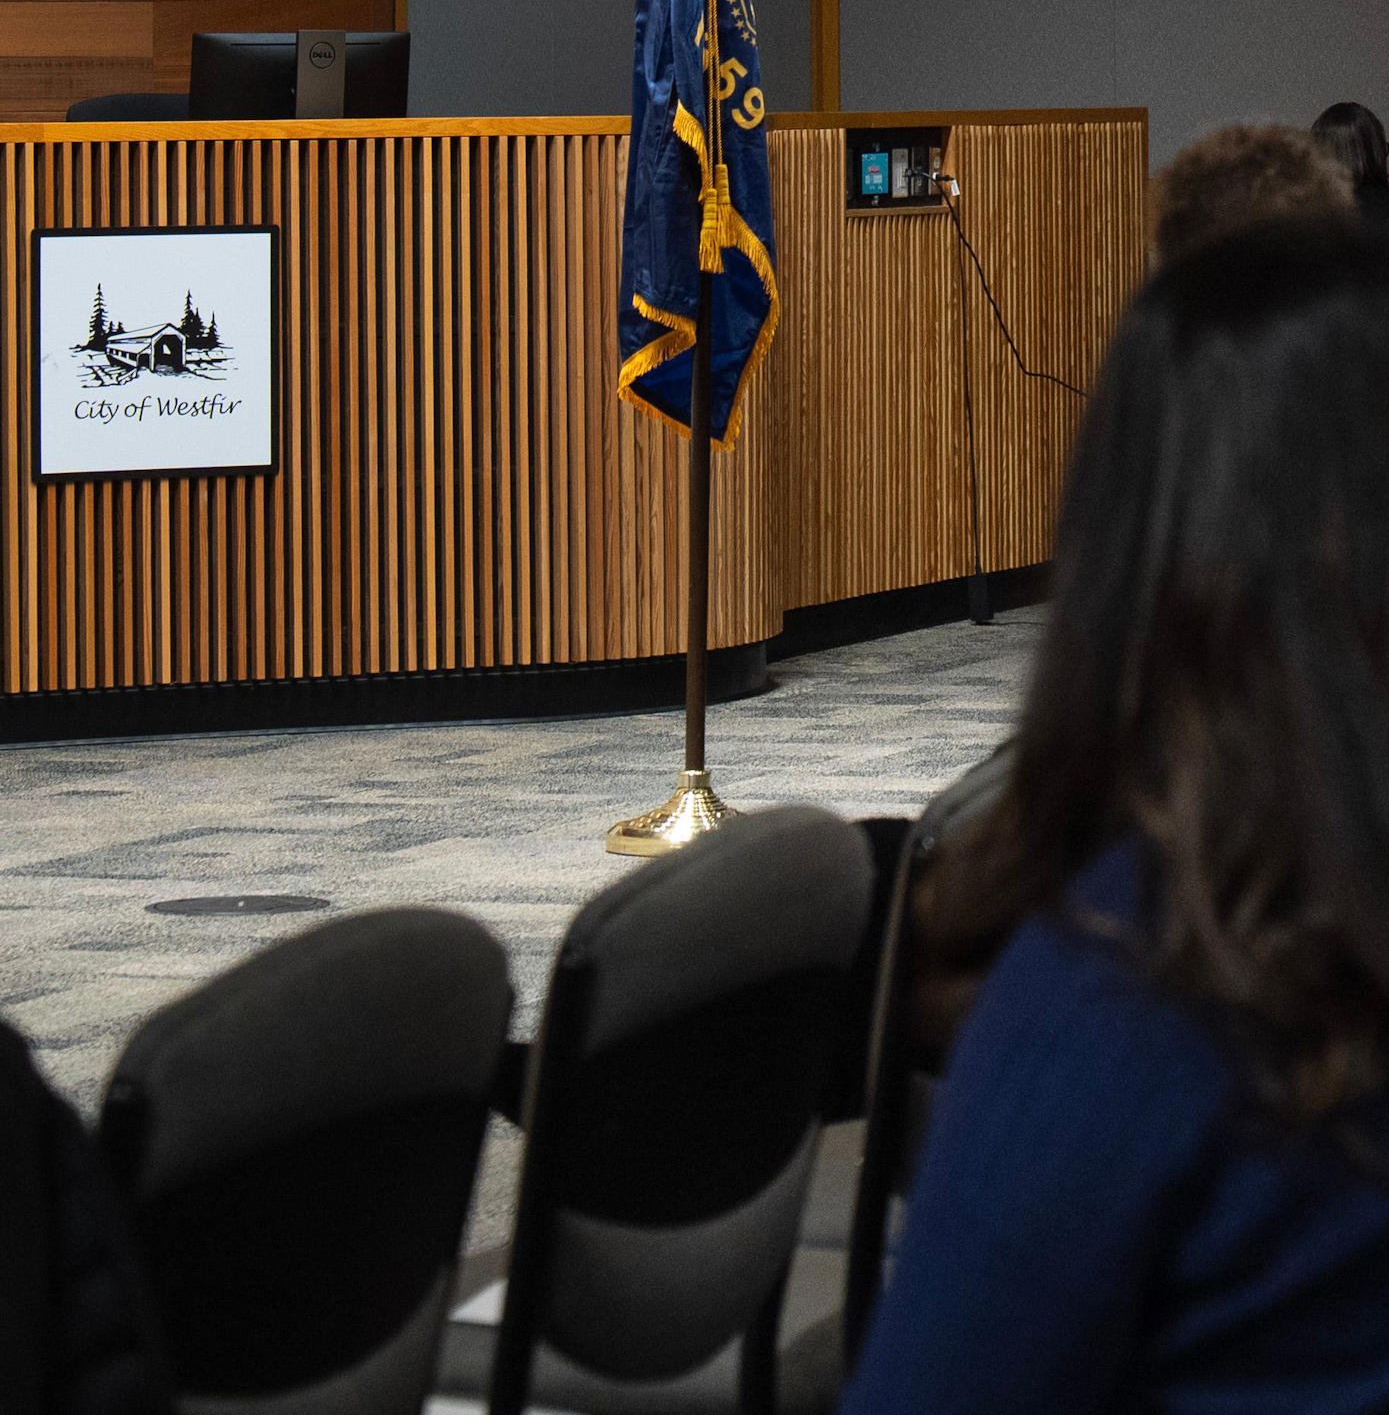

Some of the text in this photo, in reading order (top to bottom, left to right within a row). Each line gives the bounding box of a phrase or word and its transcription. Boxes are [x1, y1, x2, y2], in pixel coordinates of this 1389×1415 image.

[312, 51, 333, 59] DELL
[74, 393, 242, 424] City of Westfir
